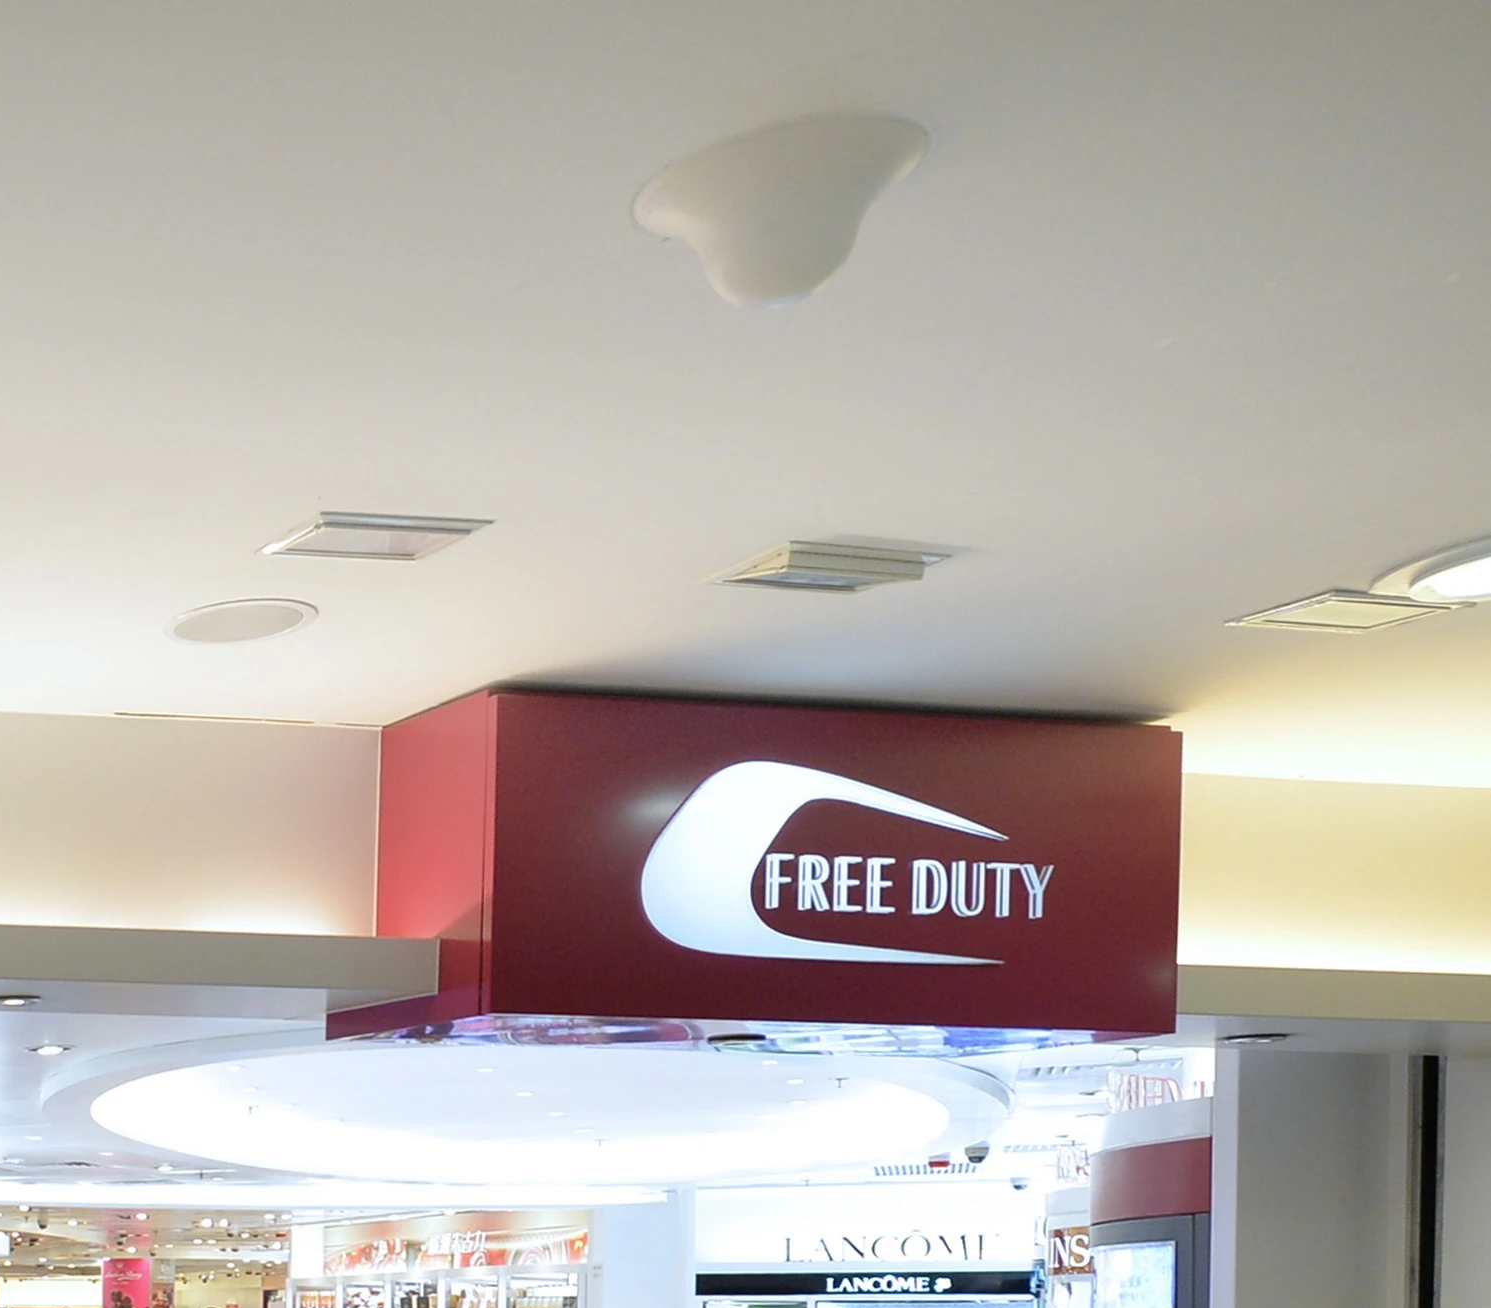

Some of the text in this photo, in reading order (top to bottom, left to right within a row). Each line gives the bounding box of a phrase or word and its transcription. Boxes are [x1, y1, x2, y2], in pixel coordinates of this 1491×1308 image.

[764, 853, 1055, 920] FREE DUTY
[825, 1274, 930, 1293] LANCÔME
